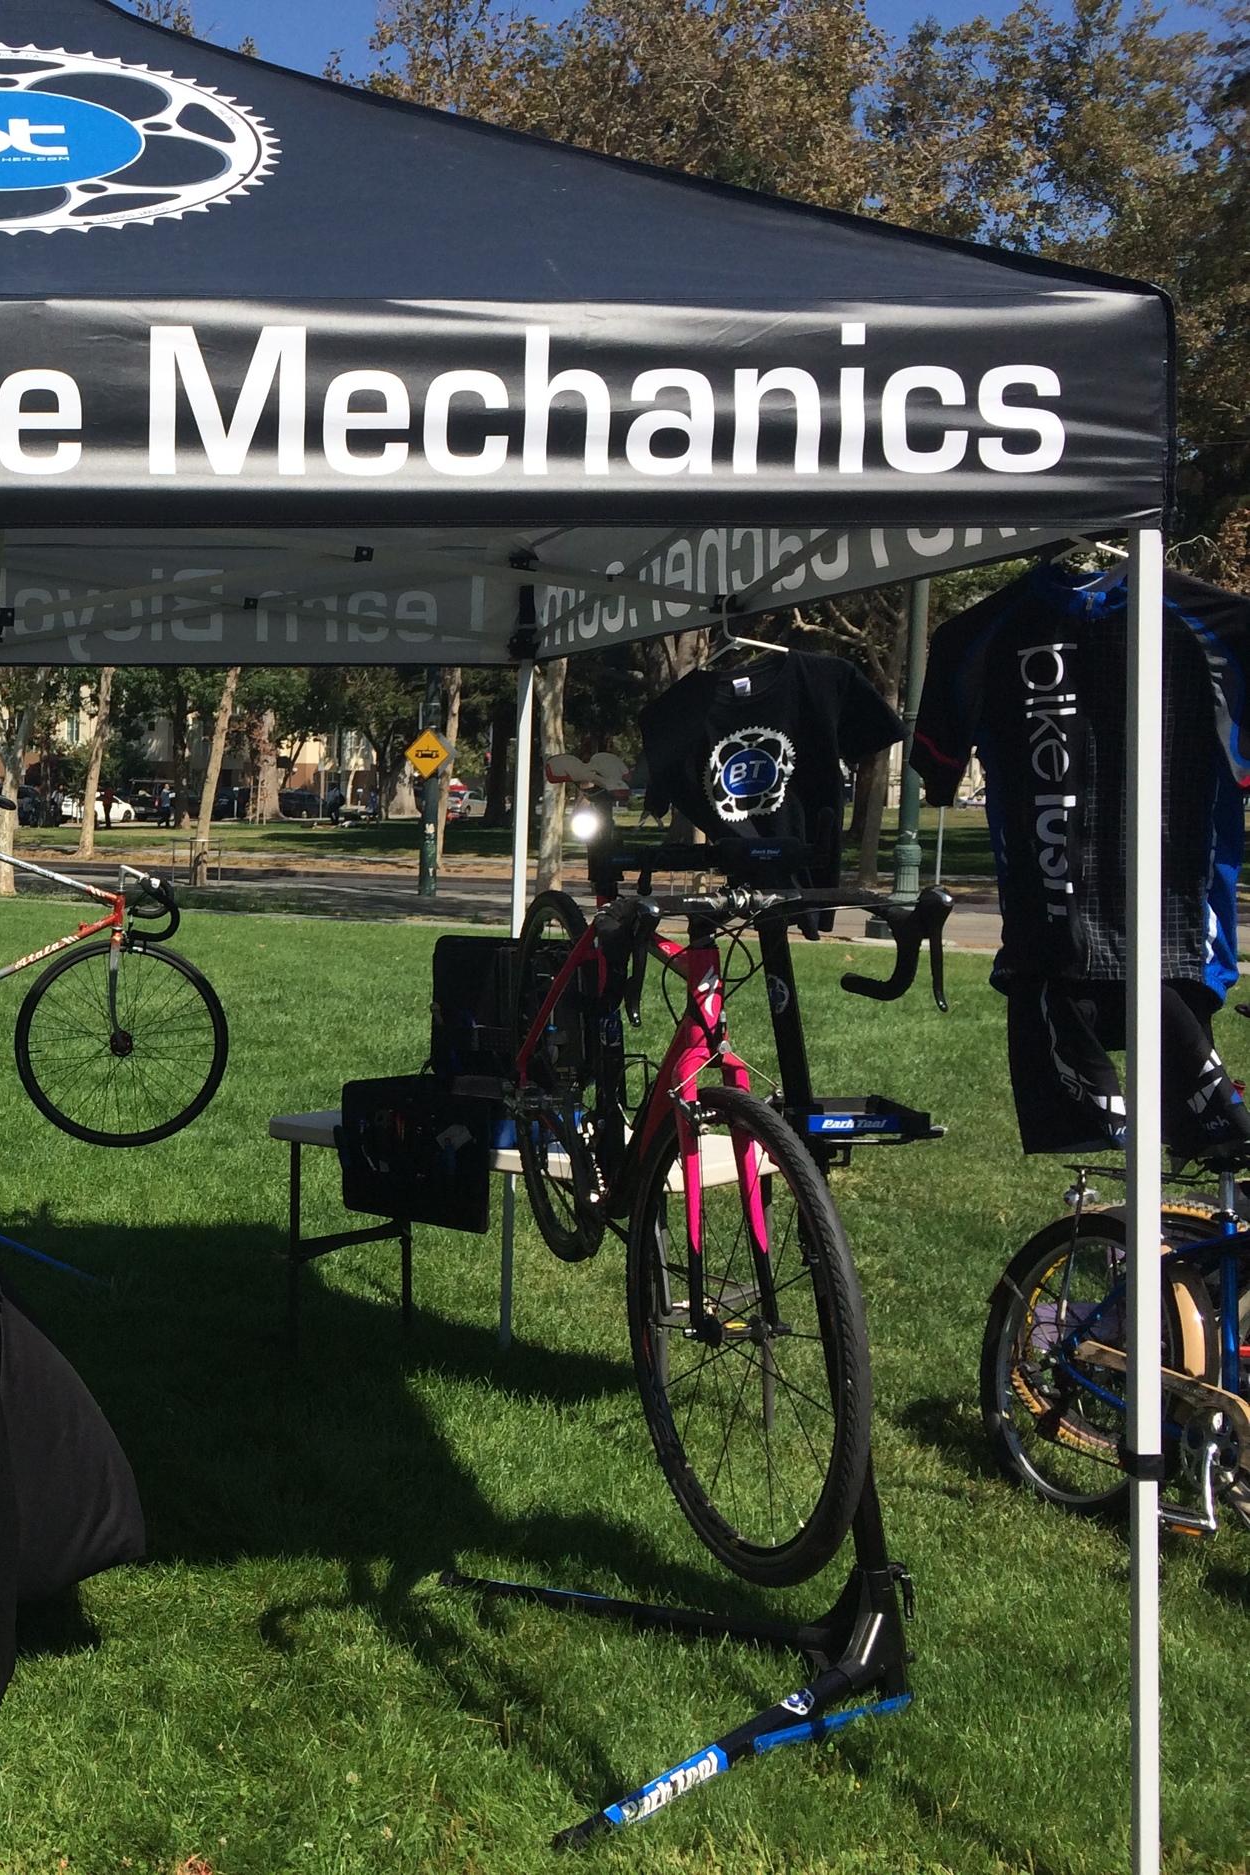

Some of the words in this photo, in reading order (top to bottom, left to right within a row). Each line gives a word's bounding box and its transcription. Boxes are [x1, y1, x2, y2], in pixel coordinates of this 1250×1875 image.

[149, 322, 1065, 476] Mechanics
[1017, 642, 1078, 783] bike
[729, 760, 767, 784] BT
[821, 1118, 855, 1129] Park
[856, 1119, 887, 1128] Tool
